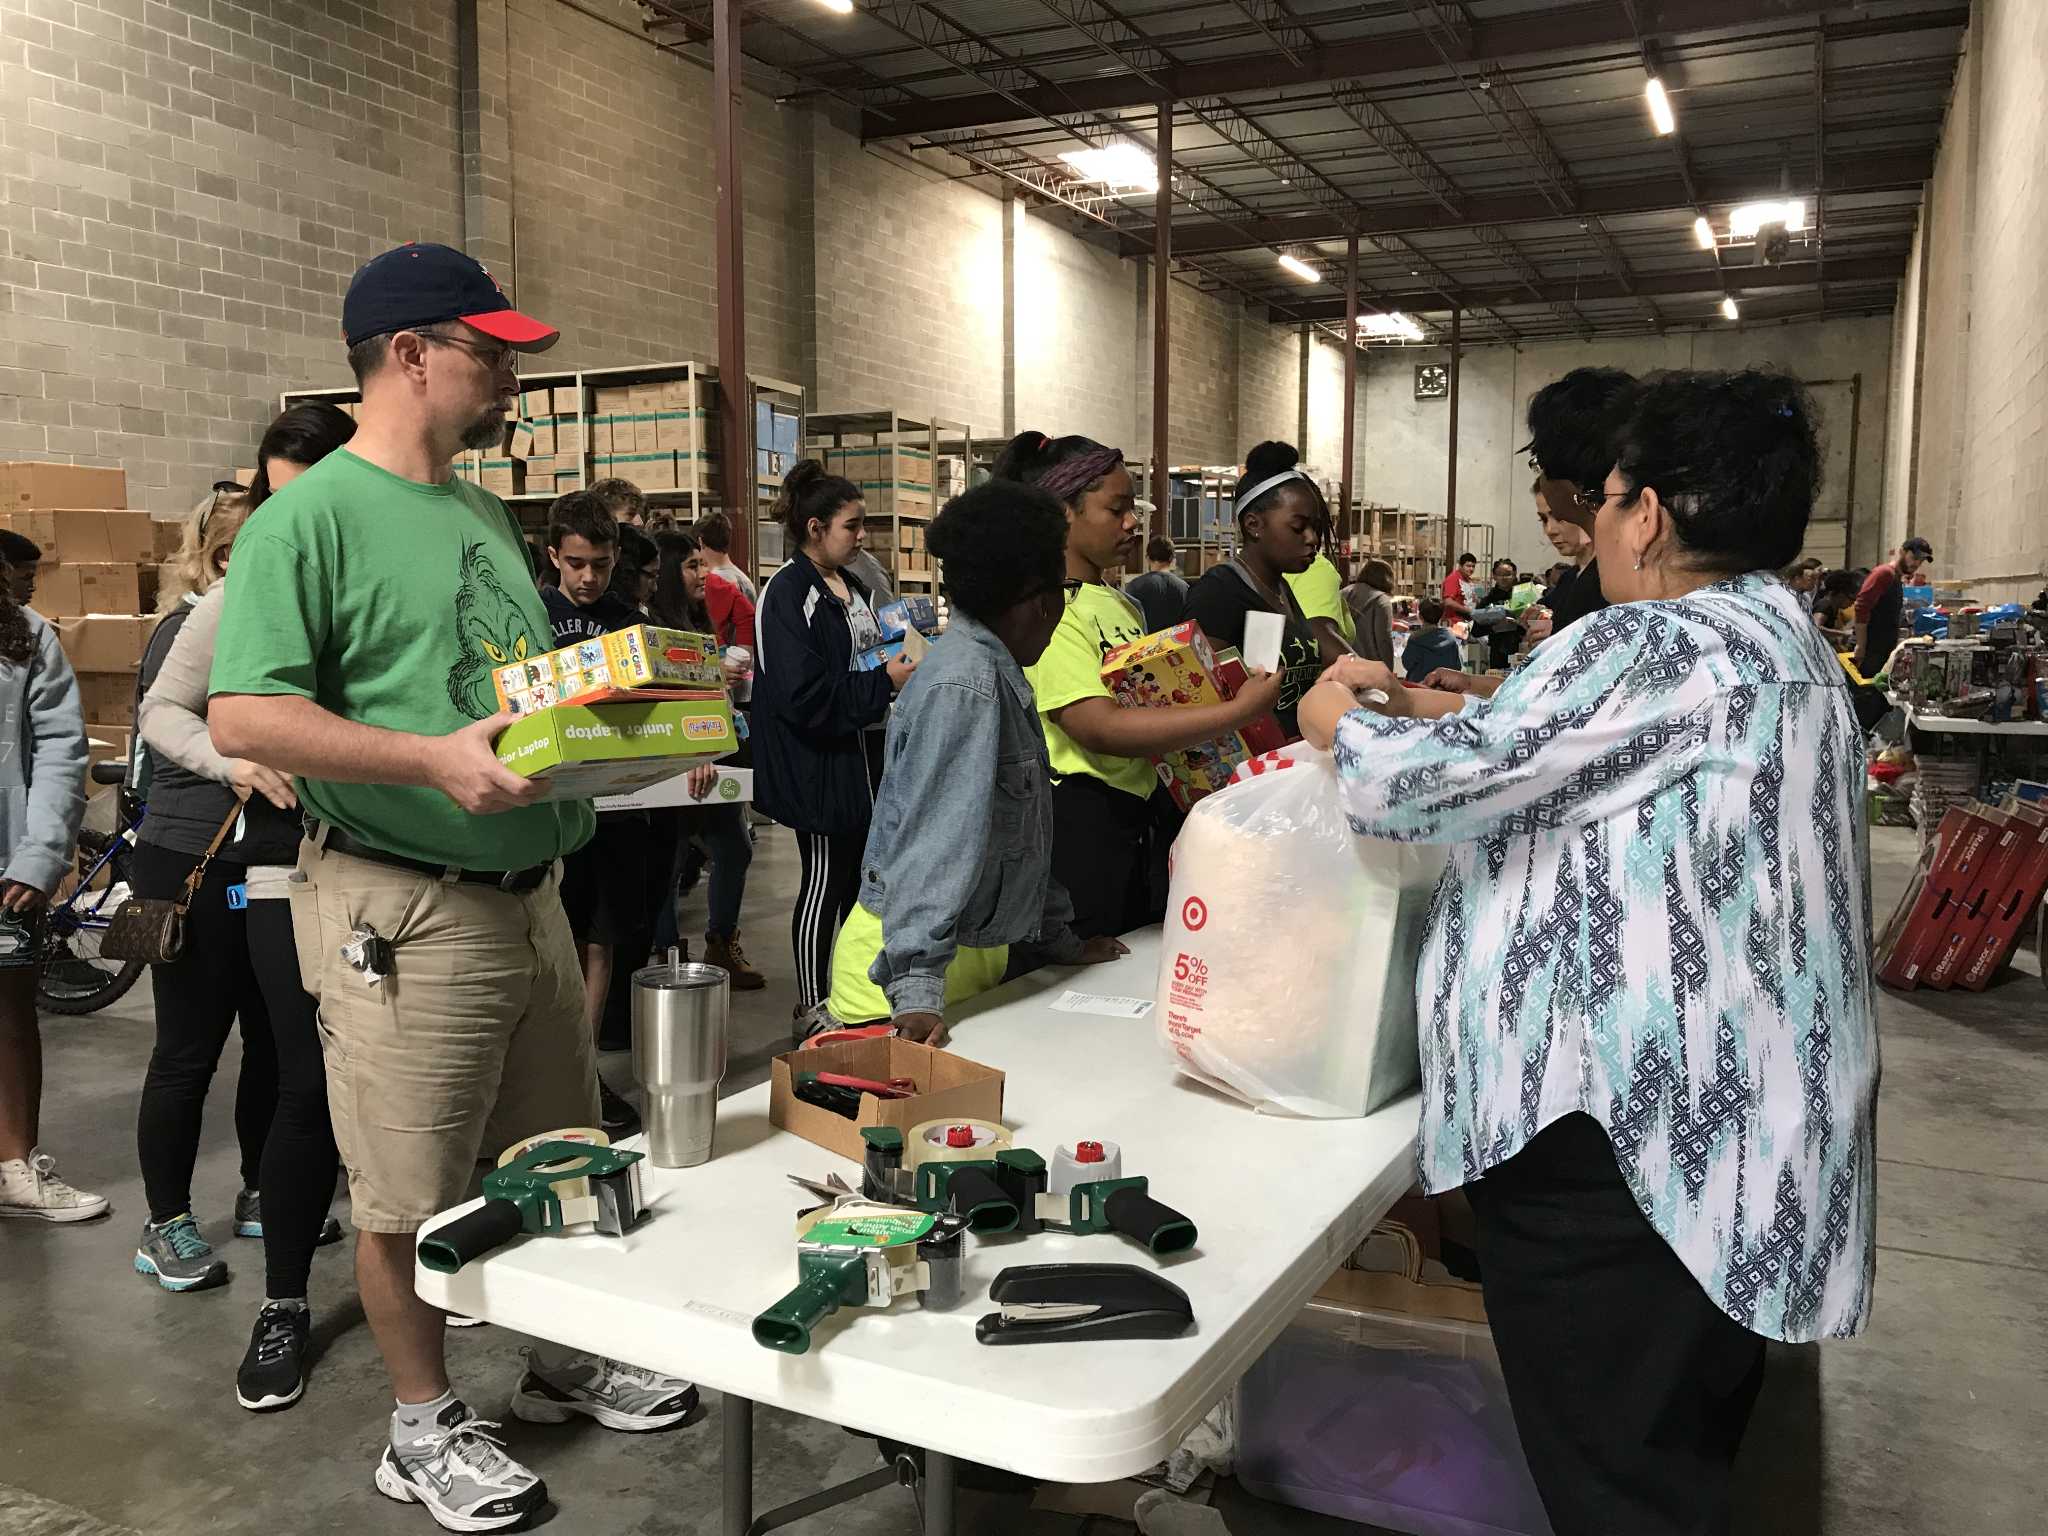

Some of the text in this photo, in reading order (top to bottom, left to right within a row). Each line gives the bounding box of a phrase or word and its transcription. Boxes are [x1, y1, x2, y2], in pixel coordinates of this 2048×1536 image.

[550, 617, 583, 638] LLER
[565, 723, 623, 740] Laptop
[627, 723, 673, 739] Junior
[518, 736, 550, 757] Laptop
[1174, 952, 1209, 980] 5%
[1188, 974, 1208, 986] OFF
